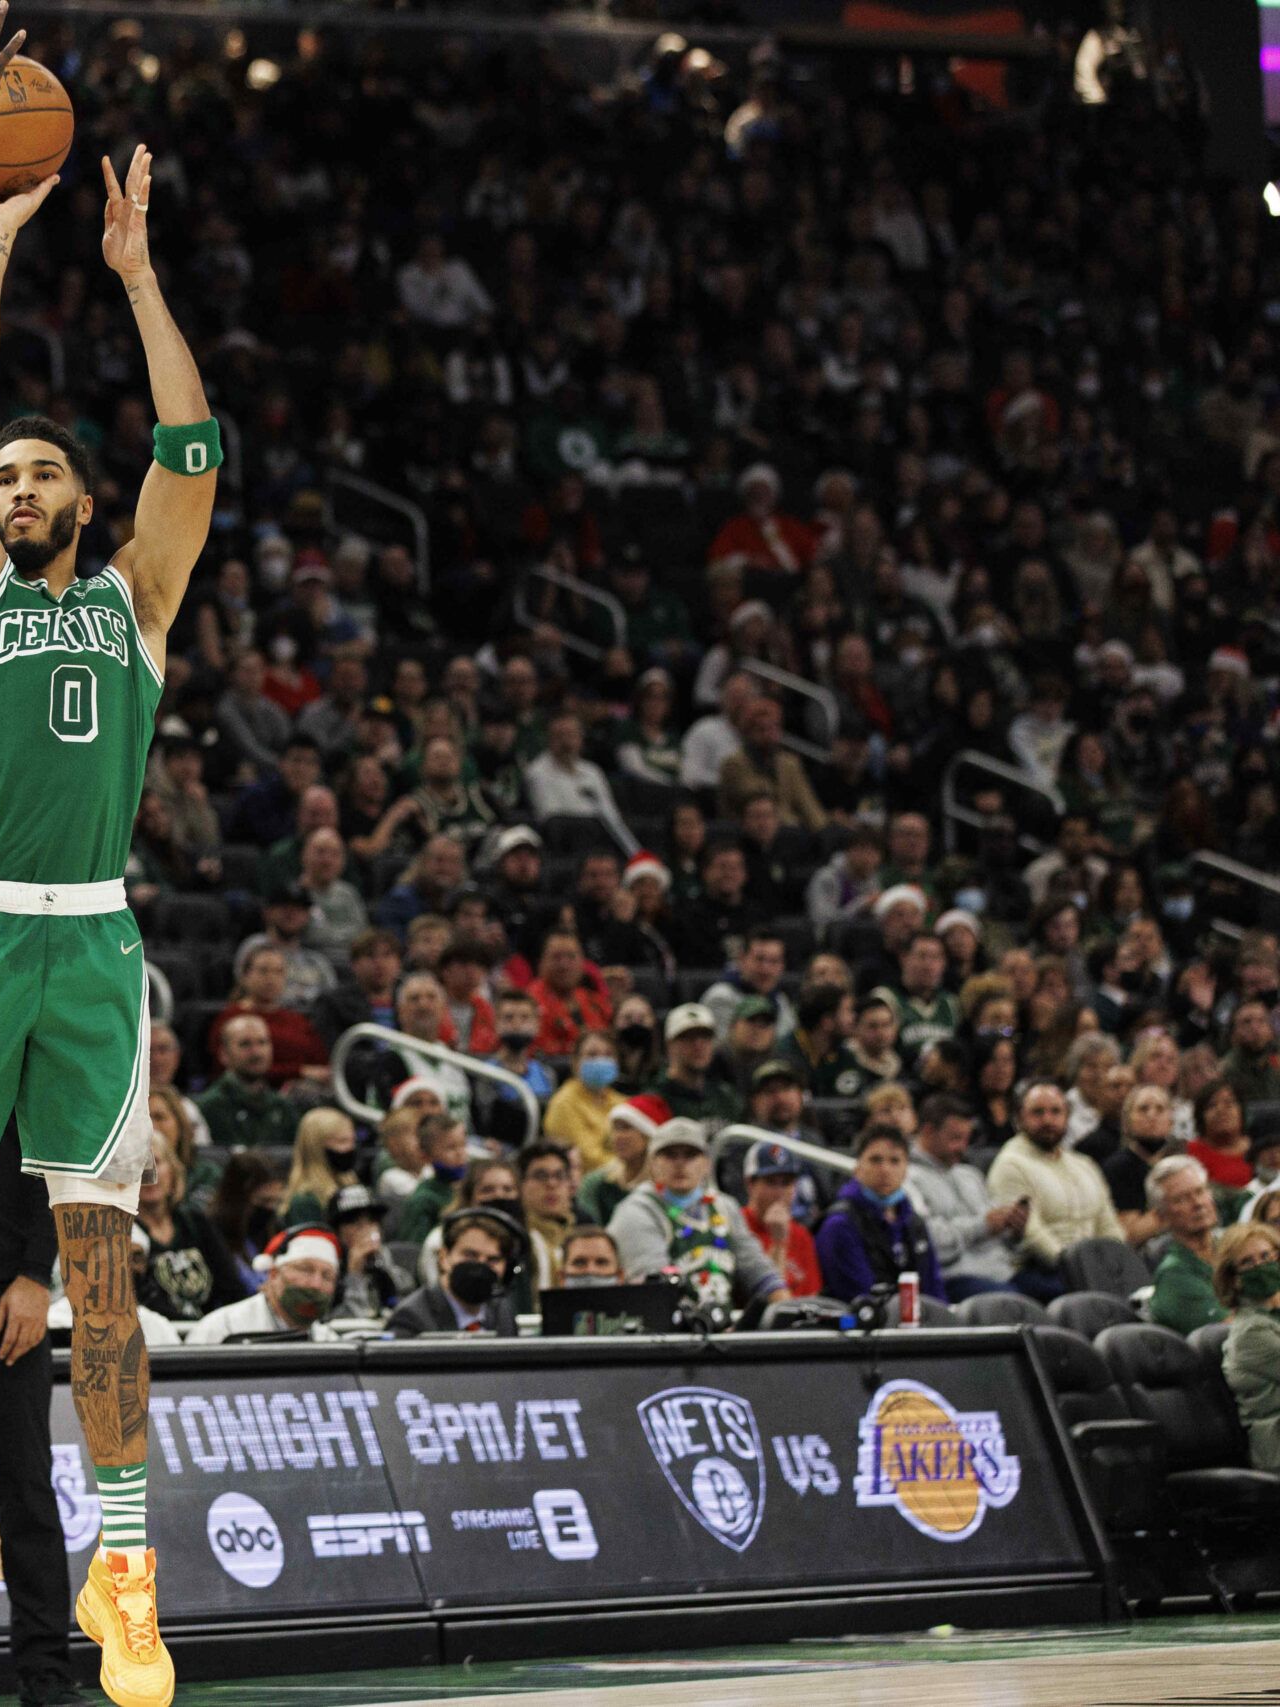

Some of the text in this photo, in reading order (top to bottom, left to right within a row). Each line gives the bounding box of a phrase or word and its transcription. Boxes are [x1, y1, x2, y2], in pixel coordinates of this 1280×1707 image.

[185, 442, 207, 473] 0
[49, 664, 99, 743] 0
[148, 1389, 589, 1474] TONIGHT 8PM/ET
[648, 1395, 756, 1465] NETS
[869, 1424, 1012, 1498] LAKERS
[216, 1519, 275, 1553] abc
[307, 1511, 432, 1558] ESPN
[450, 1507, 535, 1531] STREAMING
[507, 1529, 542, 1550] LIVE
